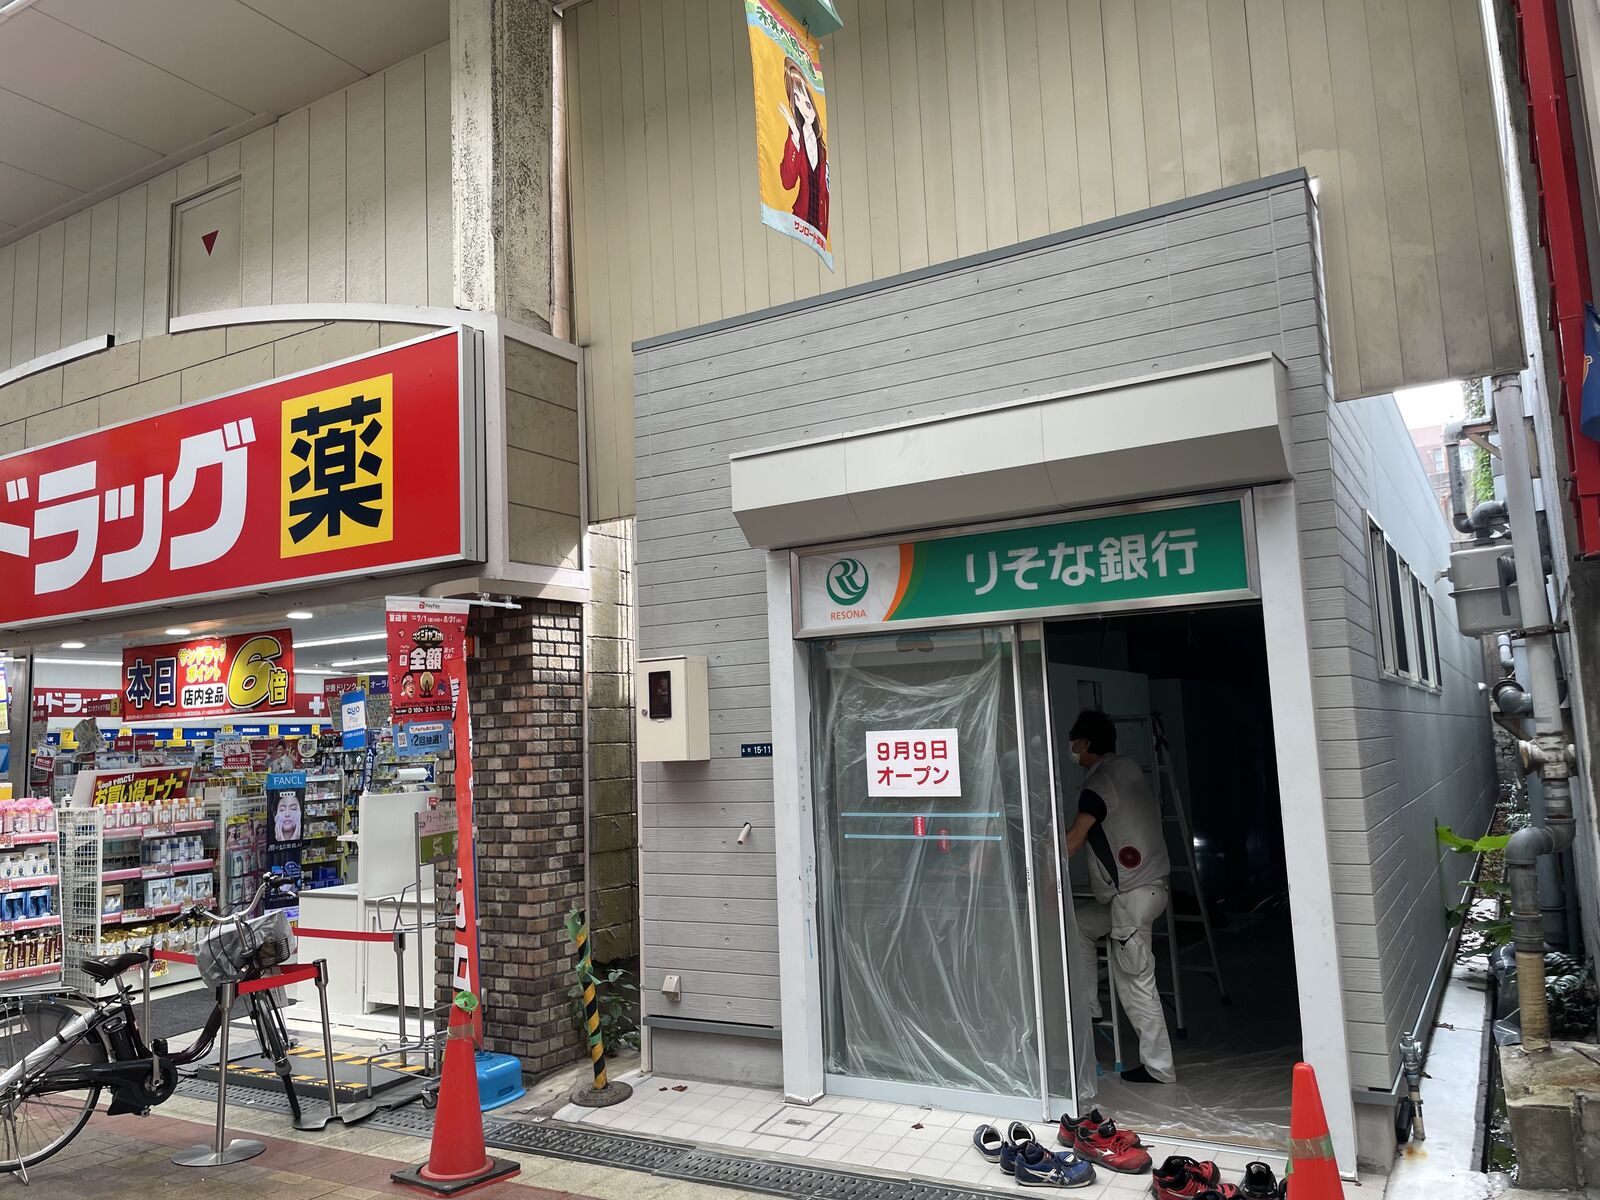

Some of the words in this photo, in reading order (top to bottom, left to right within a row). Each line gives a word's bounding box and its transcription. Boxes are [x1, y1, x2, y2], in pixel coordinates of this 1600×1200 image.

[288, 394, 383, 544] 薬
[965, 528, 1199, 595] りそな銀行
[830, 609, 867, 621] RESONA
[409, 647, 443, 670] 全額
[126, 657, 177, 708] 本日
[186, 663, 222, 683] ポイント
[112, 701, 118, 712] 3
[183, 686, 225, 706] 店内全品
[346, 705, 361, 715] QUO
[753, 746, 771, 754] 15-11
[877, 739, 948, 762] 9月9日
[273, 776, 303, 785] FANCL
[877, 765, 950, 788] オープン
[94, 773, 184, 806] お買い得コーナー
